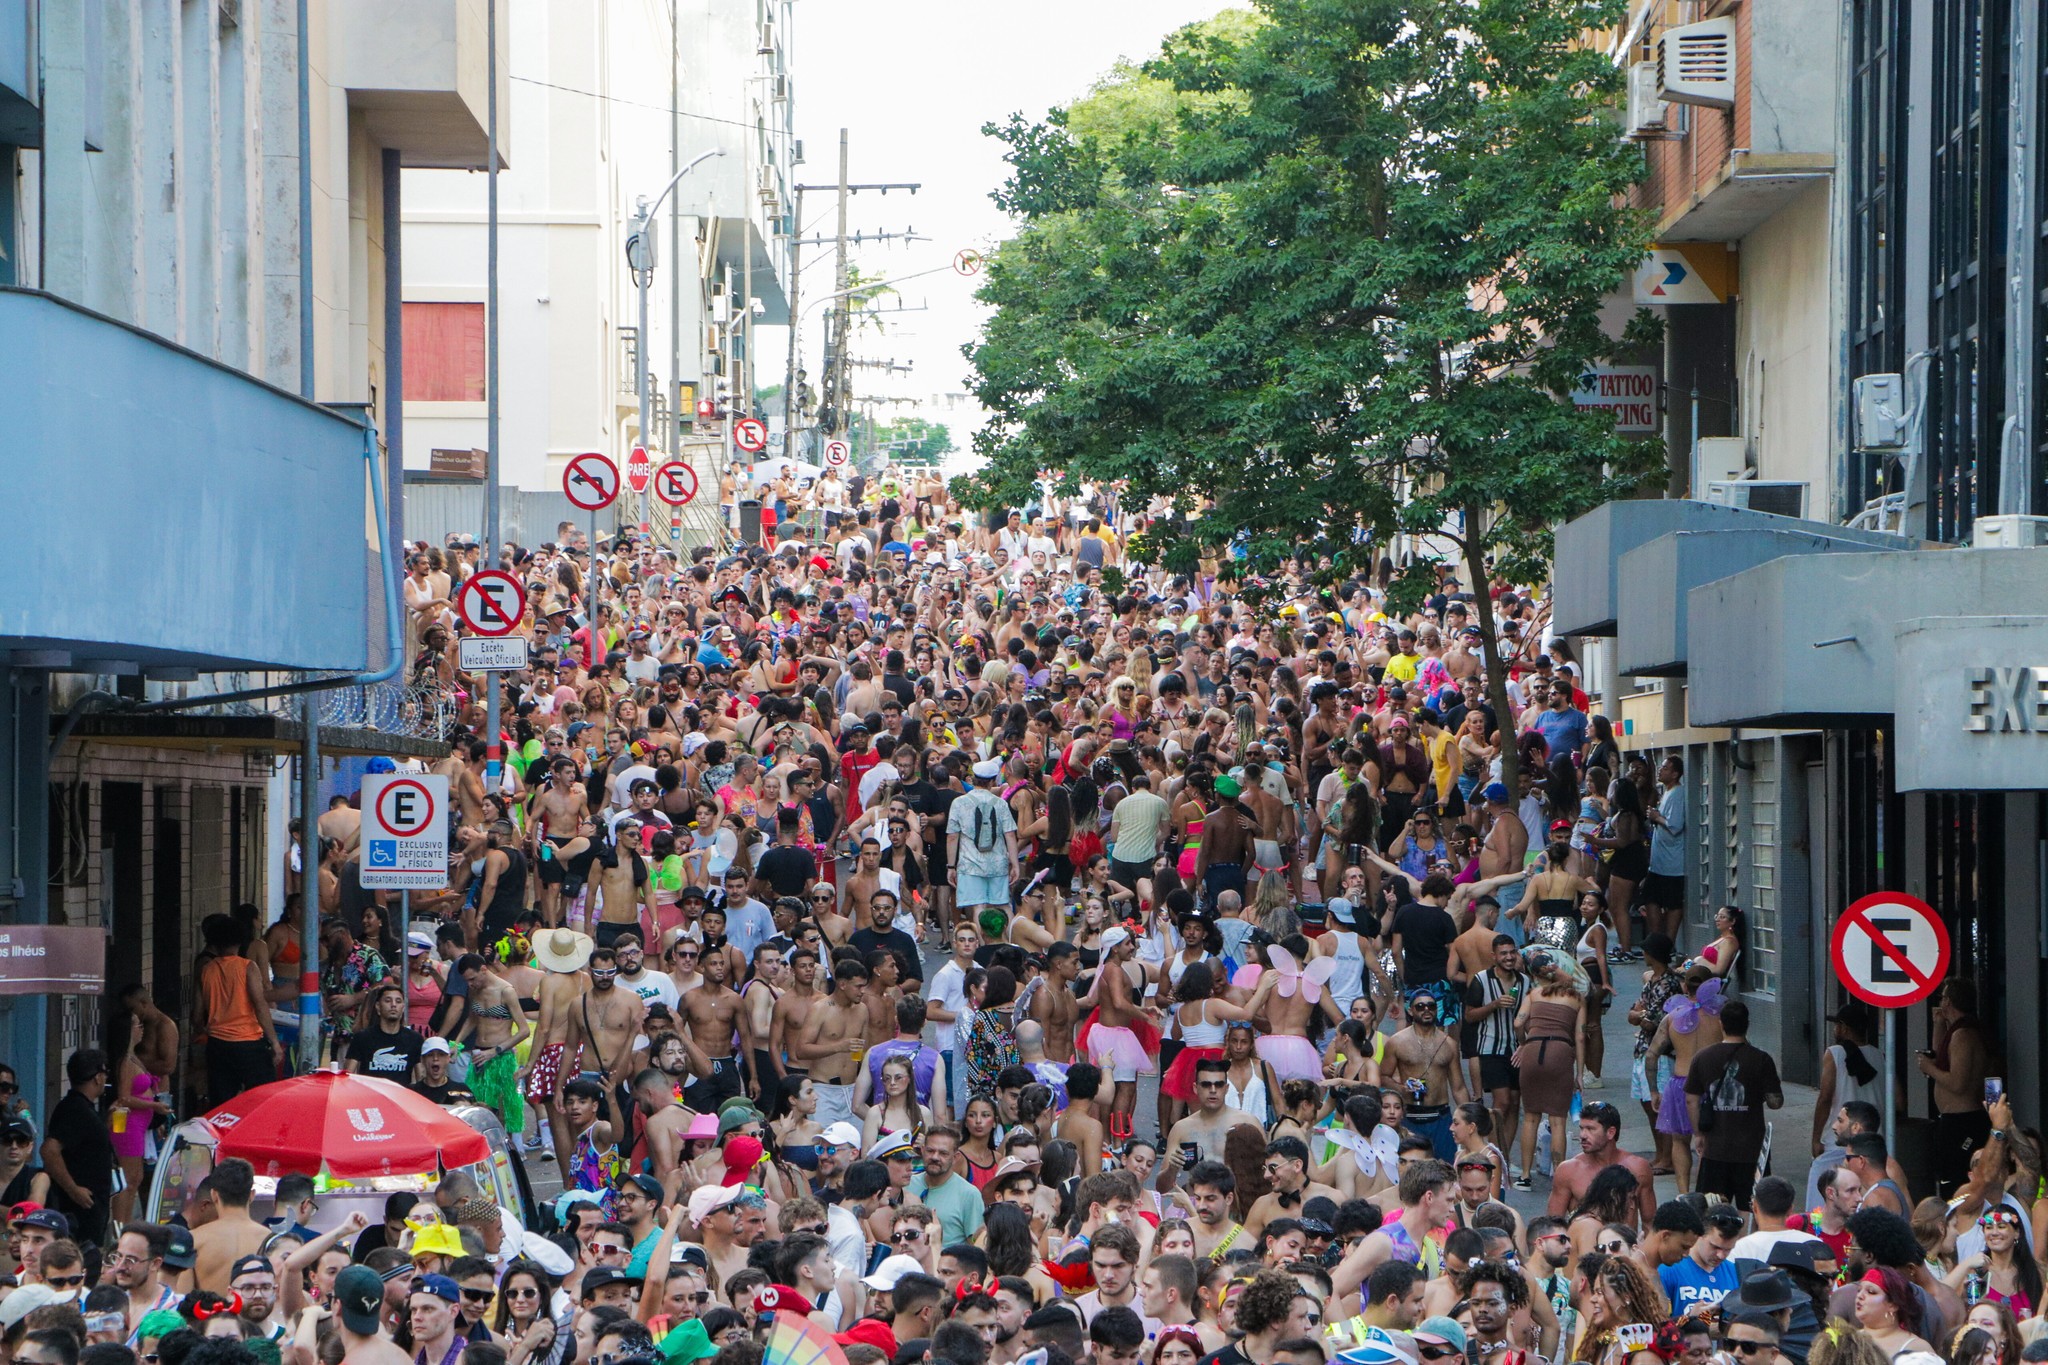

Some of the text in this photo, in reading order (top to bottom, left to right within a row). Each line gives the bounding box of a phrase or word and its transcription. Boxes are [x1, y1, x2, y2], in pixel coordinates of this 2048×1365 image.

[1599, 374, 1653, 397] TATTOO
[629, 463, 649, 476] PARE
[480, 585, 504, 622] E
[481, 643, 504, 652] Exceto
[495, 654, 521, 664] Oficiais
[395, 792, 415, 824] E
[400, 841, 442, 849] EXCLUSIVO
[399, 850, 442, 858] DEFICIENTE
[399, 875, 402, 884] O
[403, 875, 414, 884] USO
[415, 876, 422, 884] DO
[424, 874, 444, 884] CARTÃO
[12, 944, 45, 957] Ilhéus
[1871, 918, 1911, 983] E
[353, 1133, 395, 1142] Unilever
[764, 1290, 776, 1302] M
